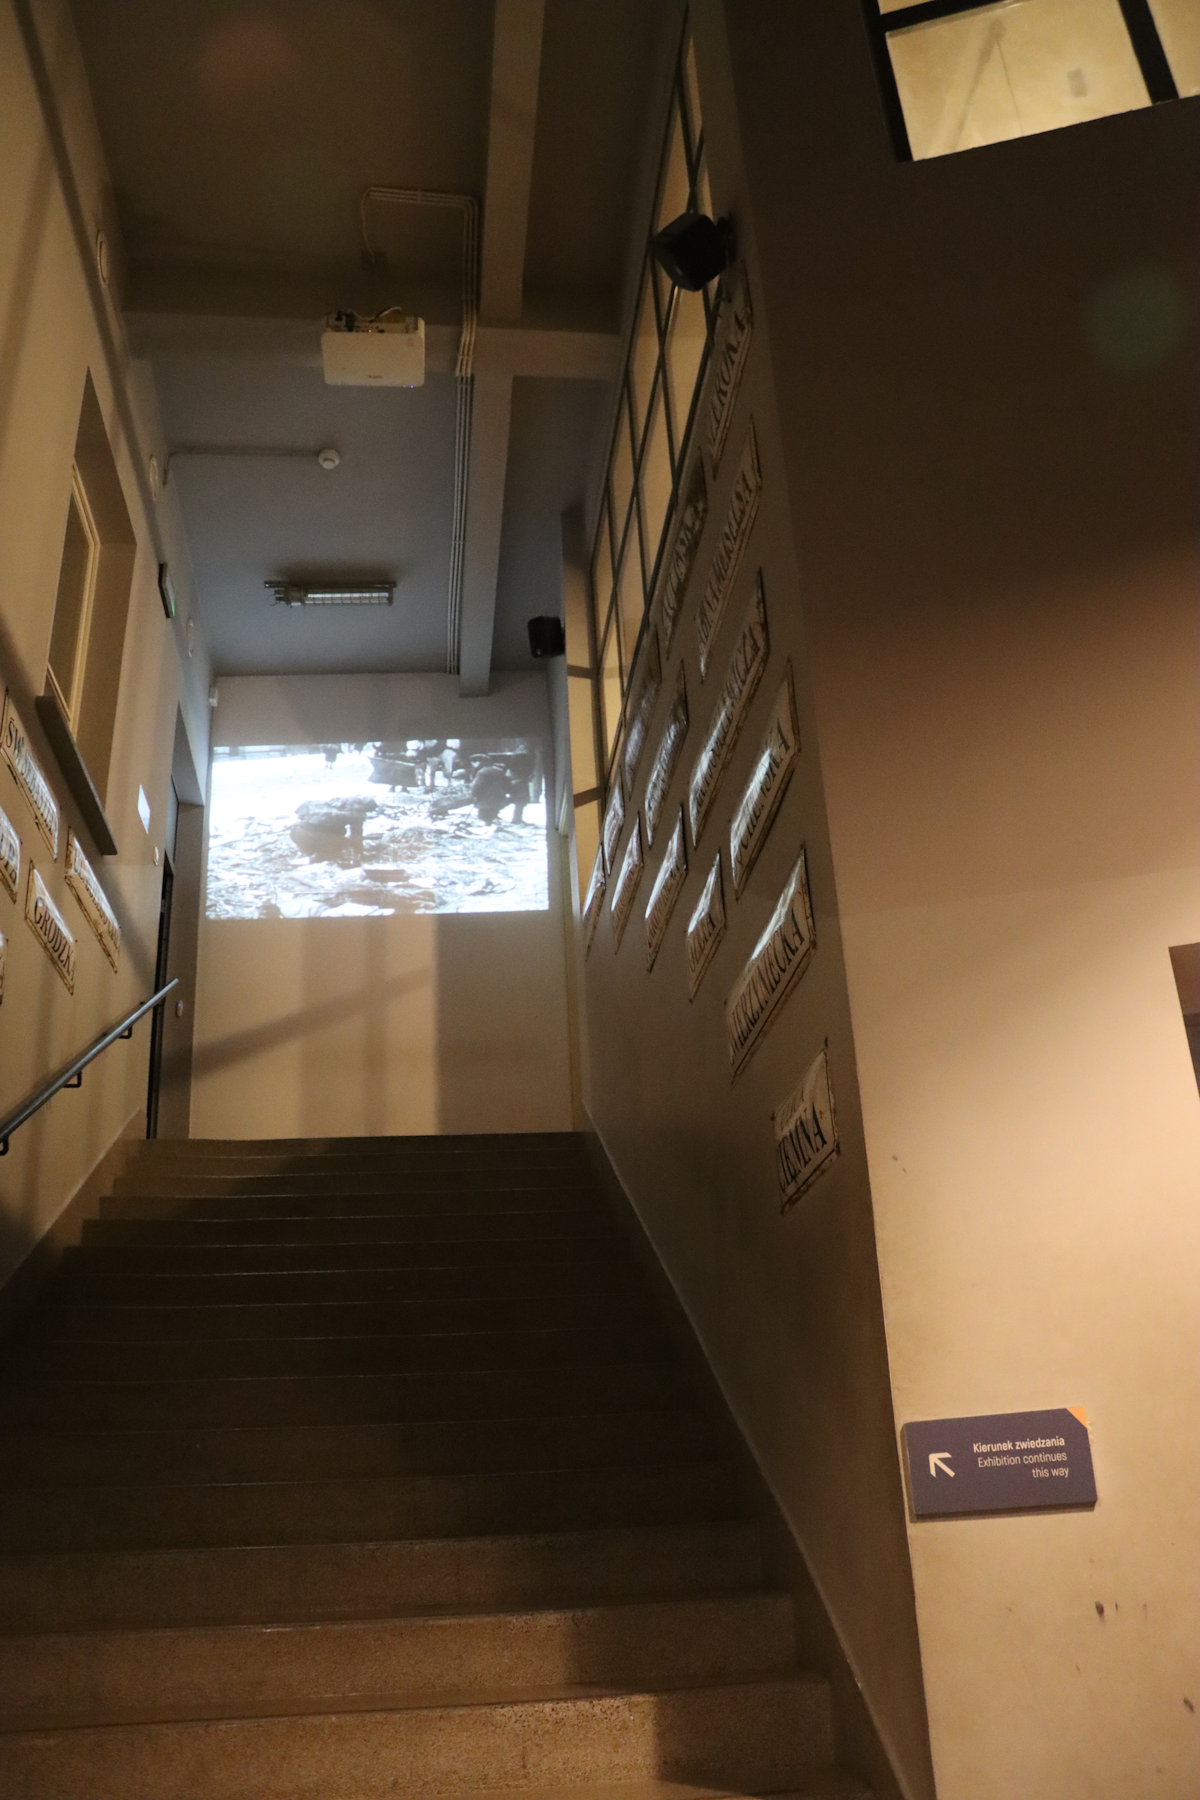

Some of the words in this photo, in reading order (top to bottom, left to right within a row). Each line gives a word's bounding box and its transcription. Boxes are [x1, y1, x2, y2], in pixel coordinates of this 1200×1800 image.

[776, 1101, 828, 1194] CIEMNA
[973, 1440, 1014, 1453] Kierunek
[1015, 1436, 1065, 1450] zwiedzania
[978, 1454, 1021, 1468] Exhibition
[1023, 1452, 1067, 1464] continues
[1032, 1467, 1049, 1478] this
[1051, 1467, 1069, 1478] way
